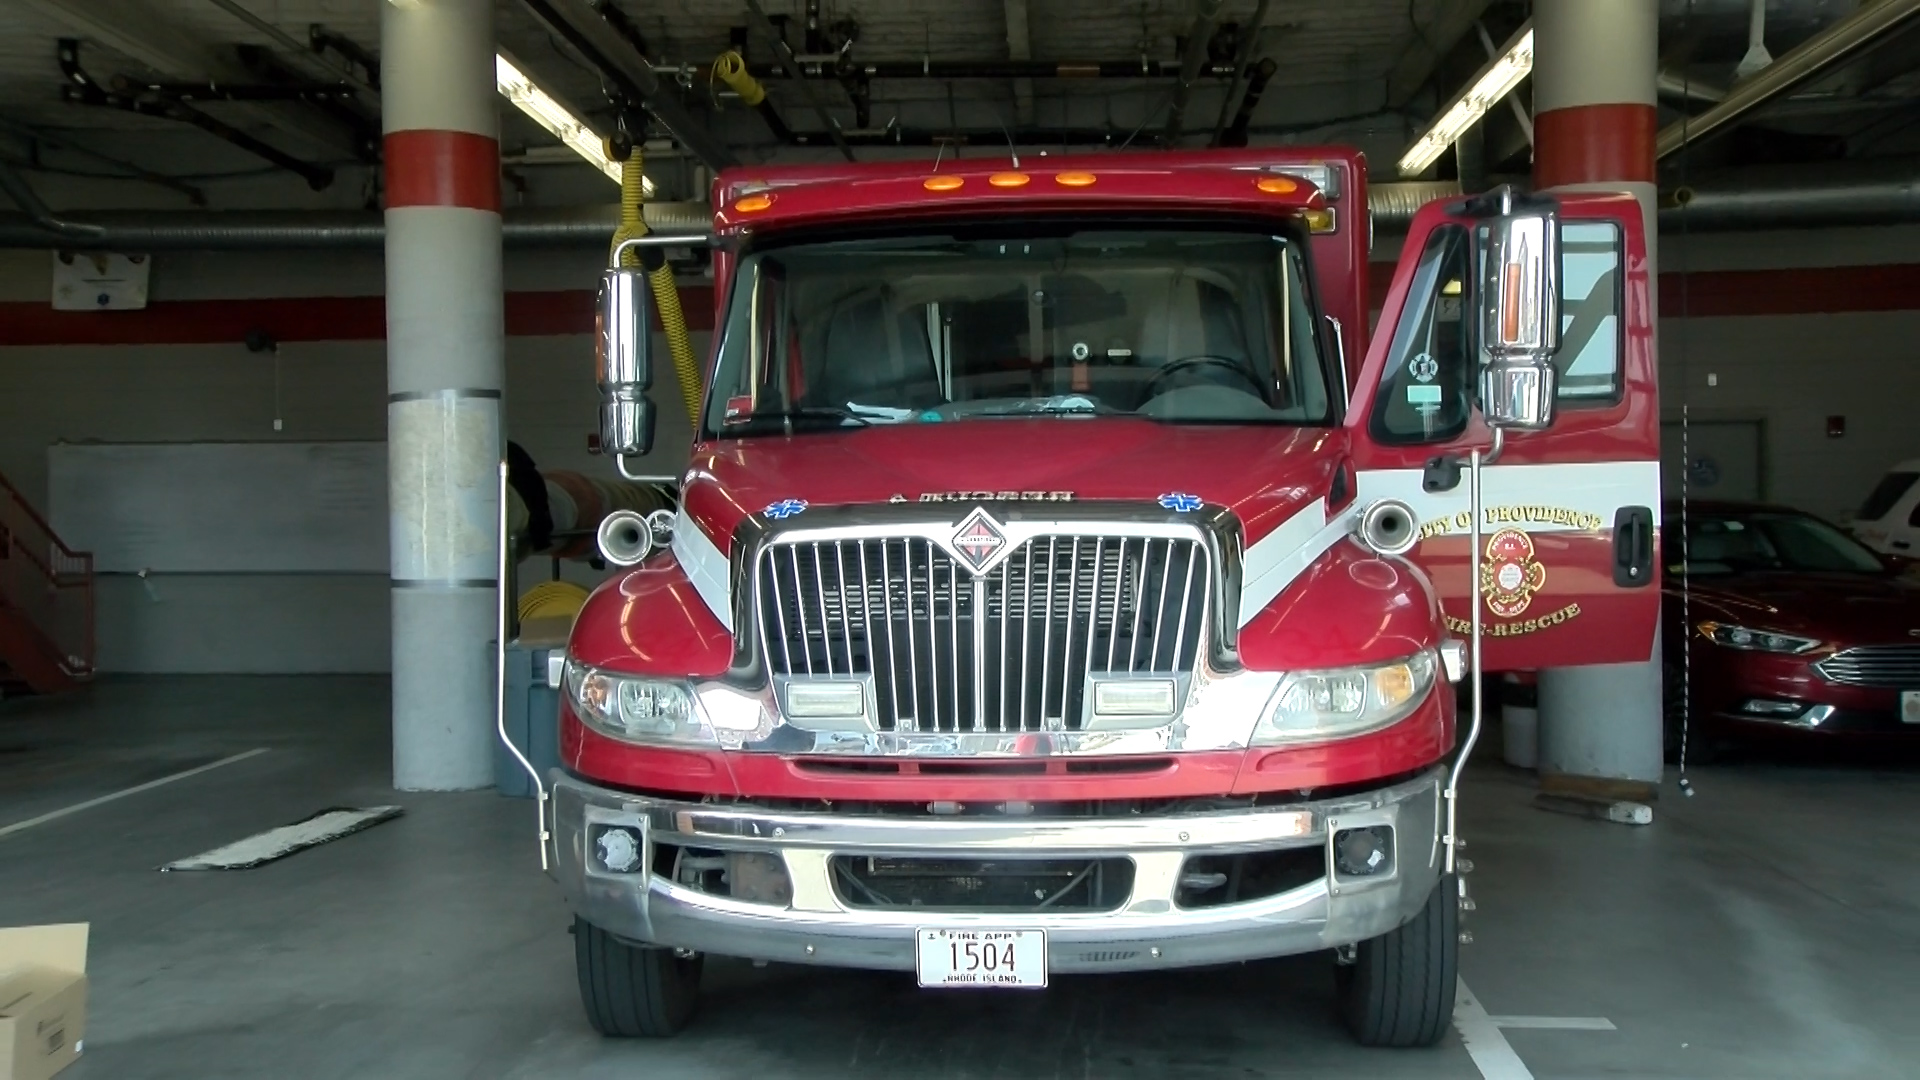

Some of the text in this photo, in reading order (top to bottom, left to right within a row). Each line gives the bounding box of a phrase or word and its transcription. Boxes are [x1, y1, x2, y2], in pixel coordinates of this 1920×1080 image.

[1485, 505, 1603, 530] PROVIDENCE
[1447, 602, 1581, 636] IRE-RESCUE
[950, 942, 1015, 972] 1504
[947, 974, 1017, 983] RHODE ISLAND
